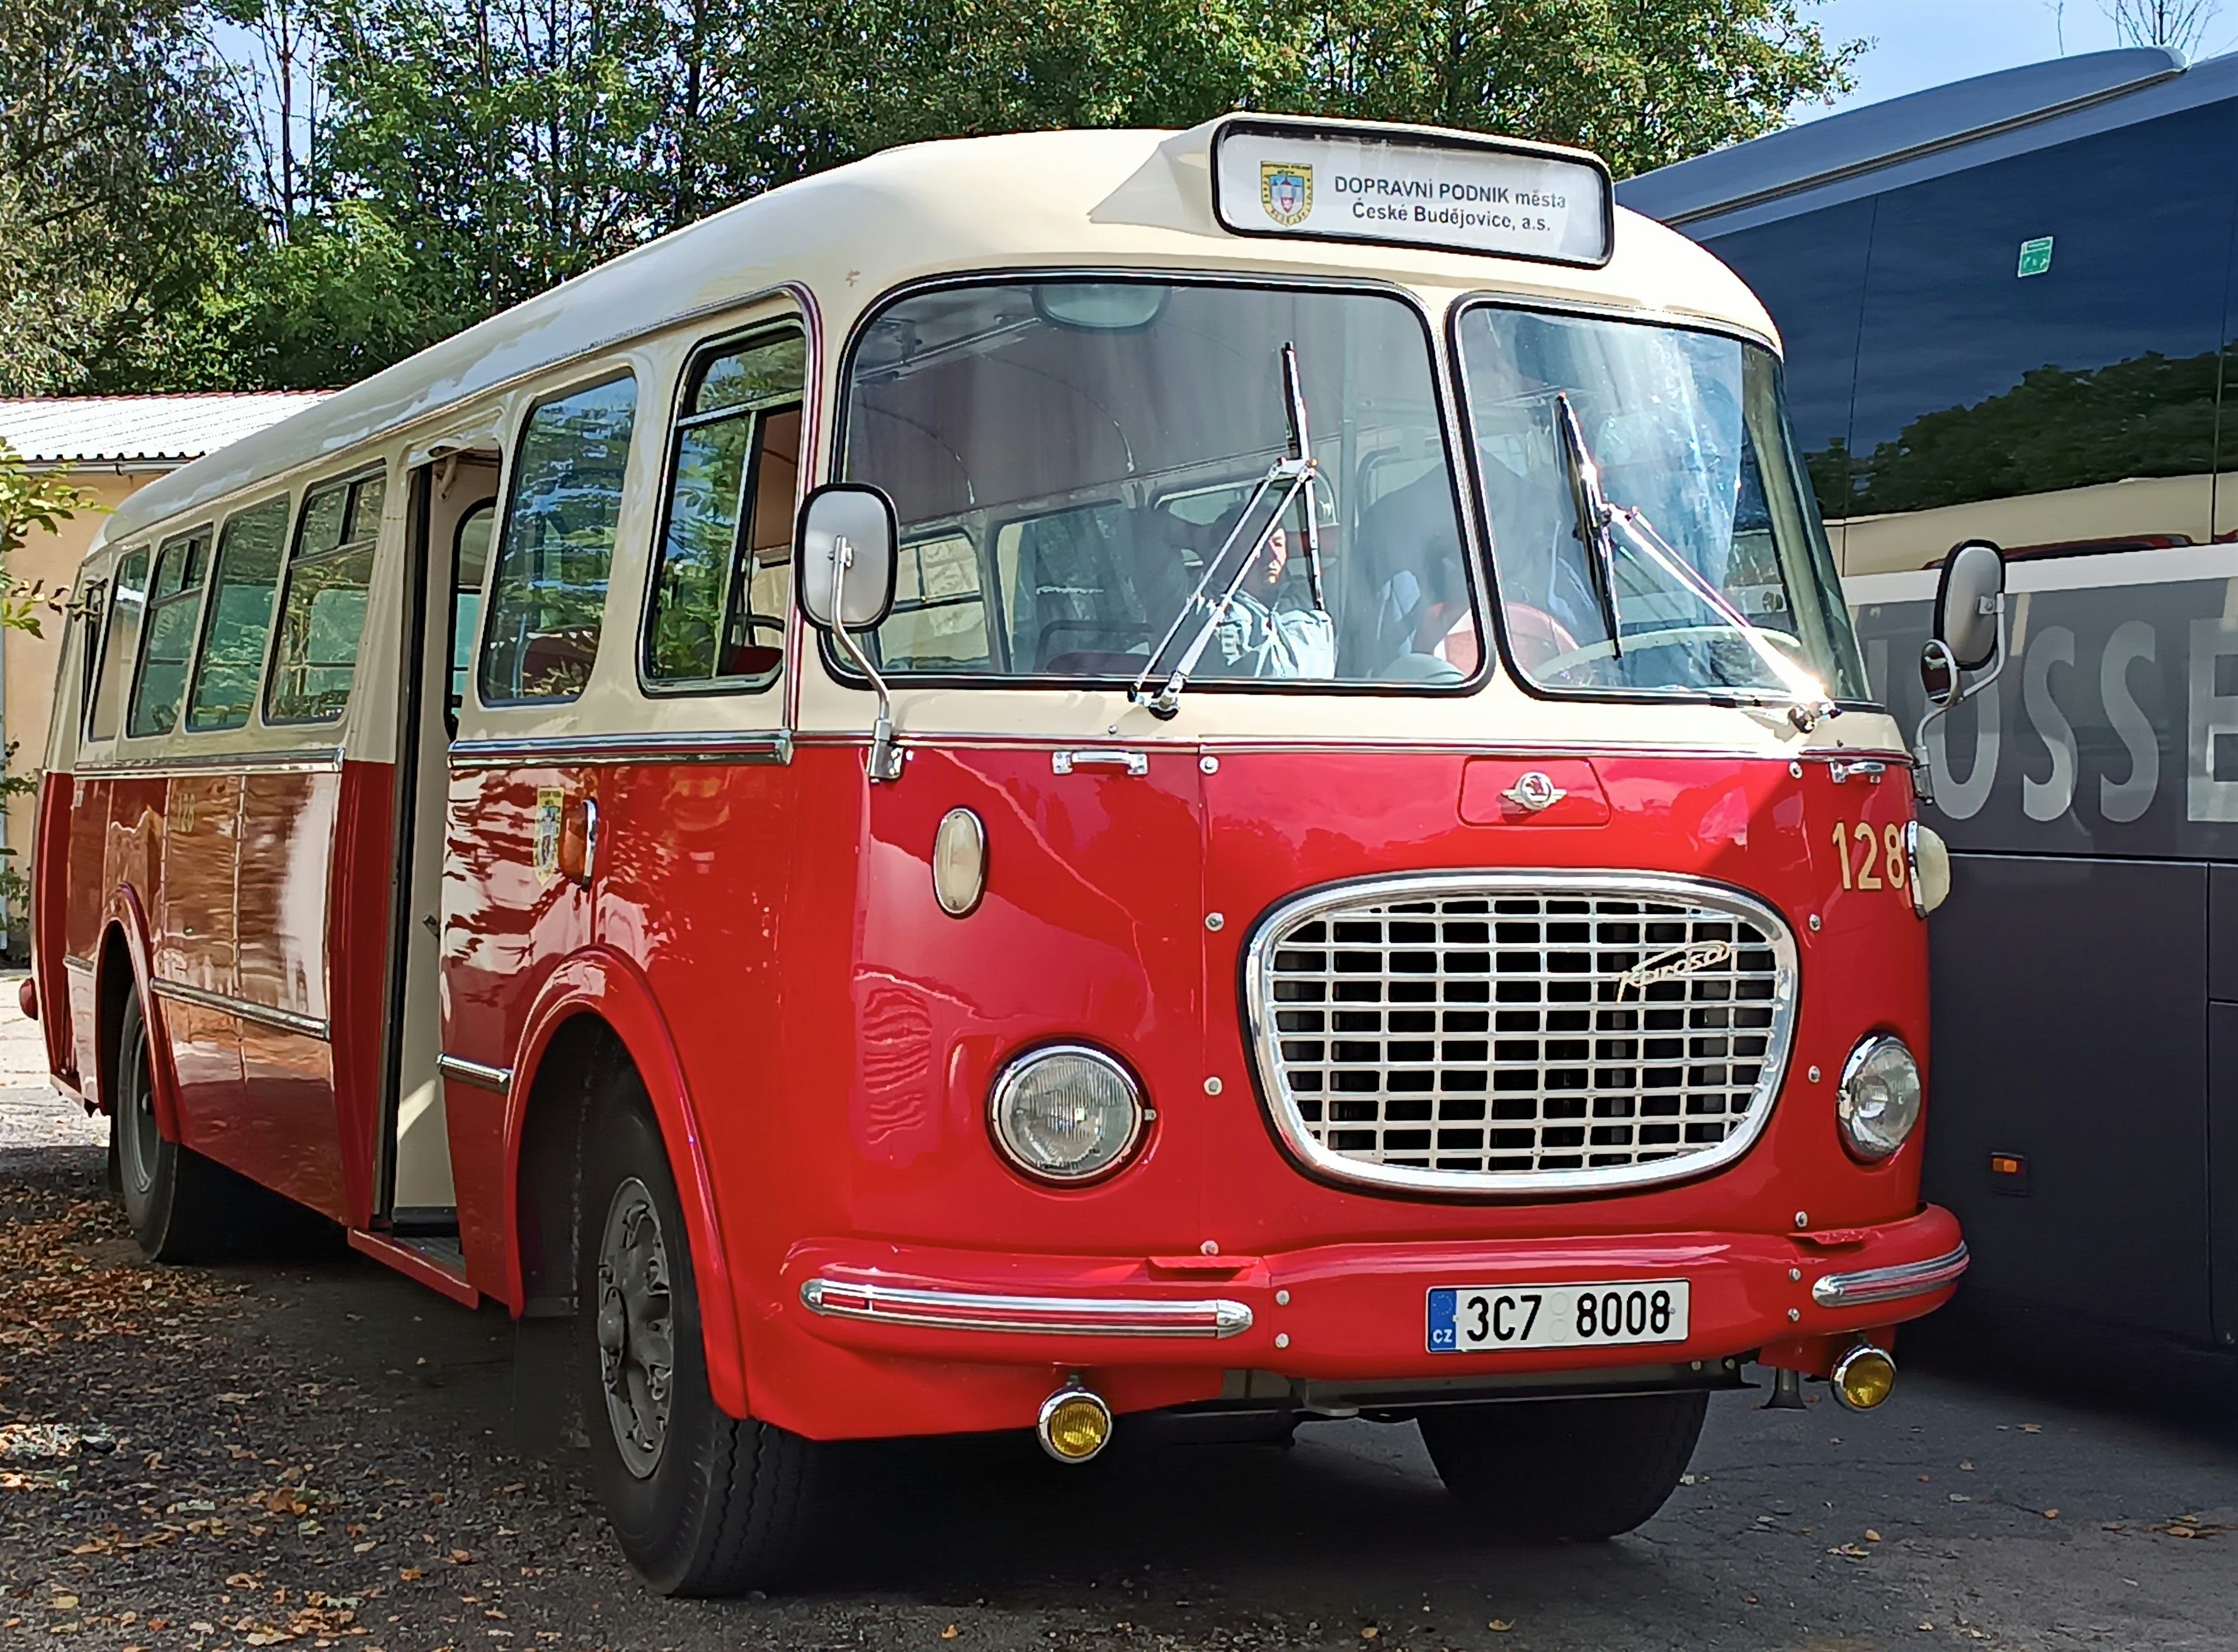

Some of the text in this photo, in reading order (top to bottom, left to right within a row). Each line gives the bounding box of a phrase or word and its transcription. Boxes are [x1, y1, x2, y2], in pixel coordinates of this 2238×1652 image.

[1334, 176, 1566, 209] DOPRAVNÍ PODNIK města
[1352, 196, 1551, 232] České Budějovice, a.s.
[1832, 822, 1905, 890] 128
[1466, 1289, 1671, 1342] 3C7 8008
[1432, 1328, 1453, 1344] CZ
